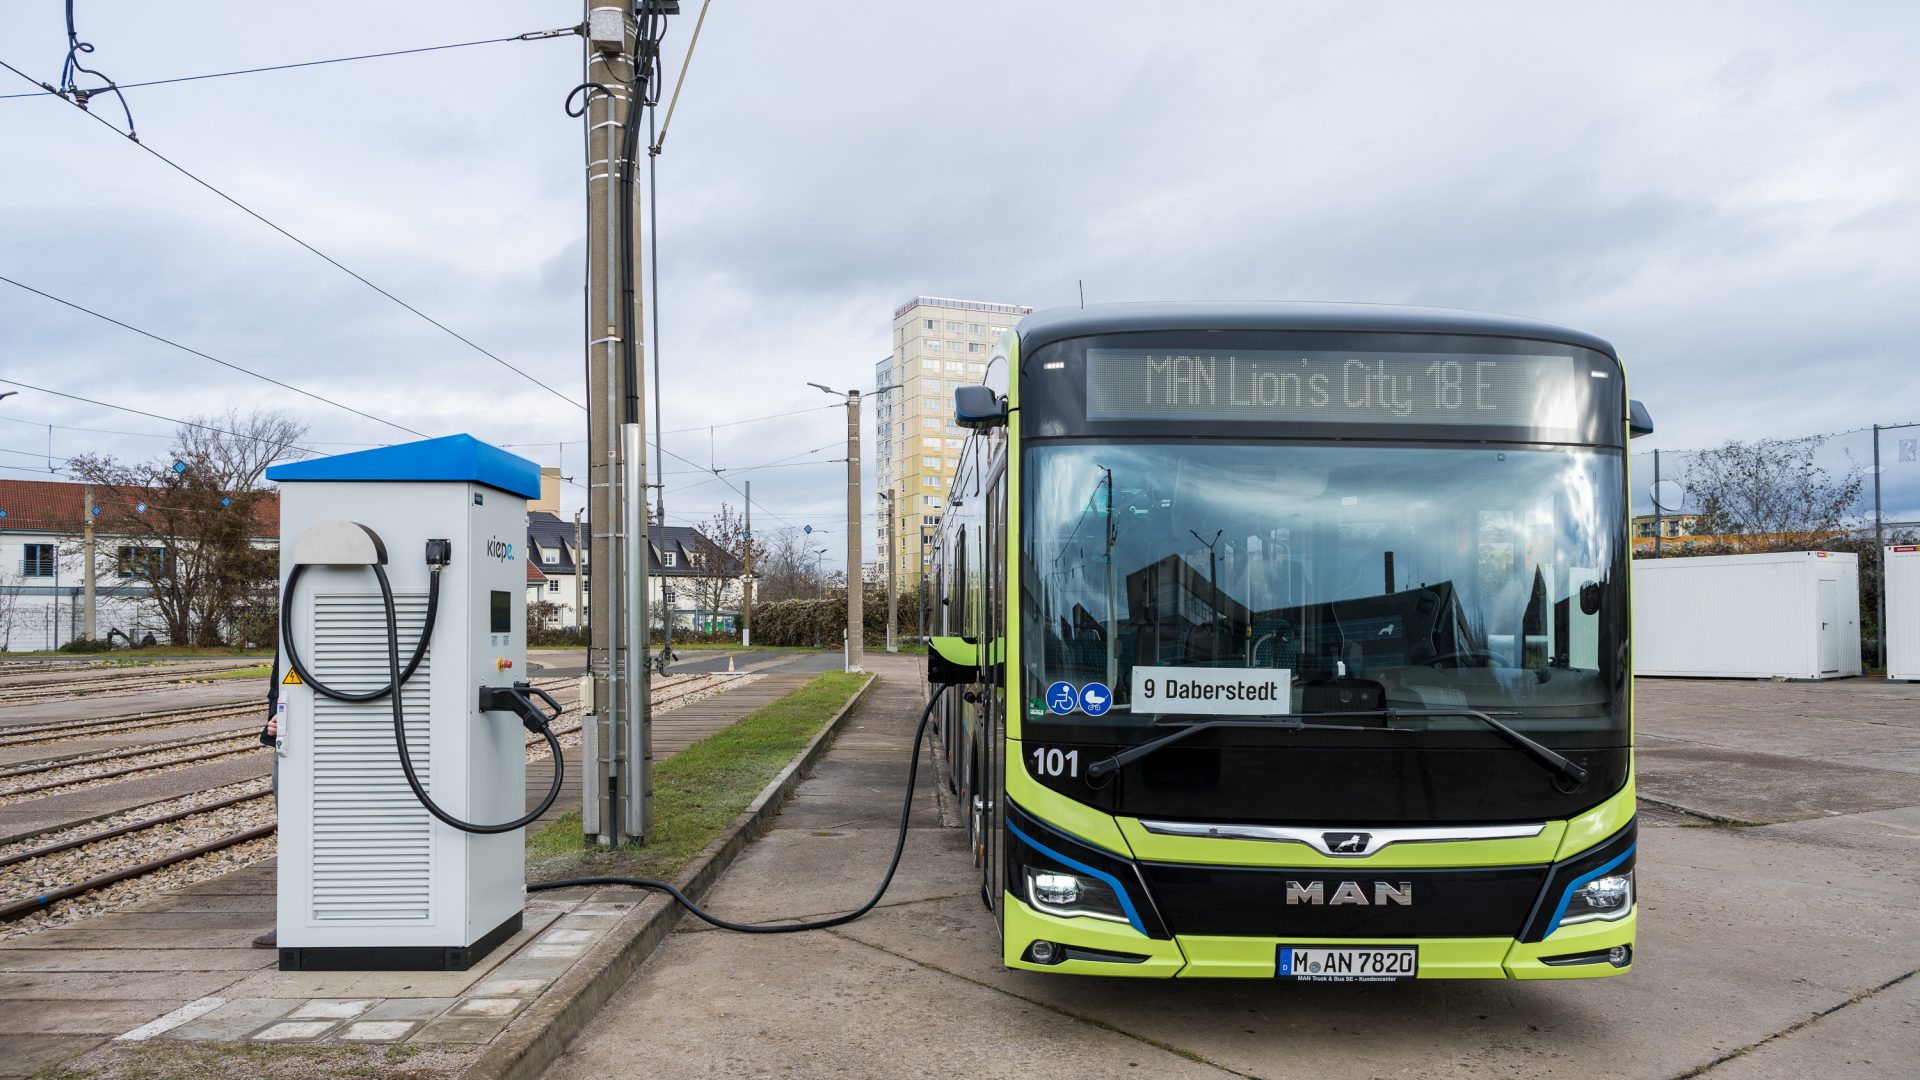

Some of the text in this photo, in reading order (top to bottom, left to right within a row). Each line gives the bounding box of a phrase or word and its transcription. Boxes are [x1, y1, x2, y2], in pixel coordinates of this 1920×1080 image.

[1146, 355, 1497, 417] MAN Lion's City 18 E
[1144, 678, 1278, 701] 9 Daberstedt
[1033, 747, 1078, 778] 101
[1285, 880, 1413, 906] MAN
[1293, 952, 1413, 973] M AN 7820
